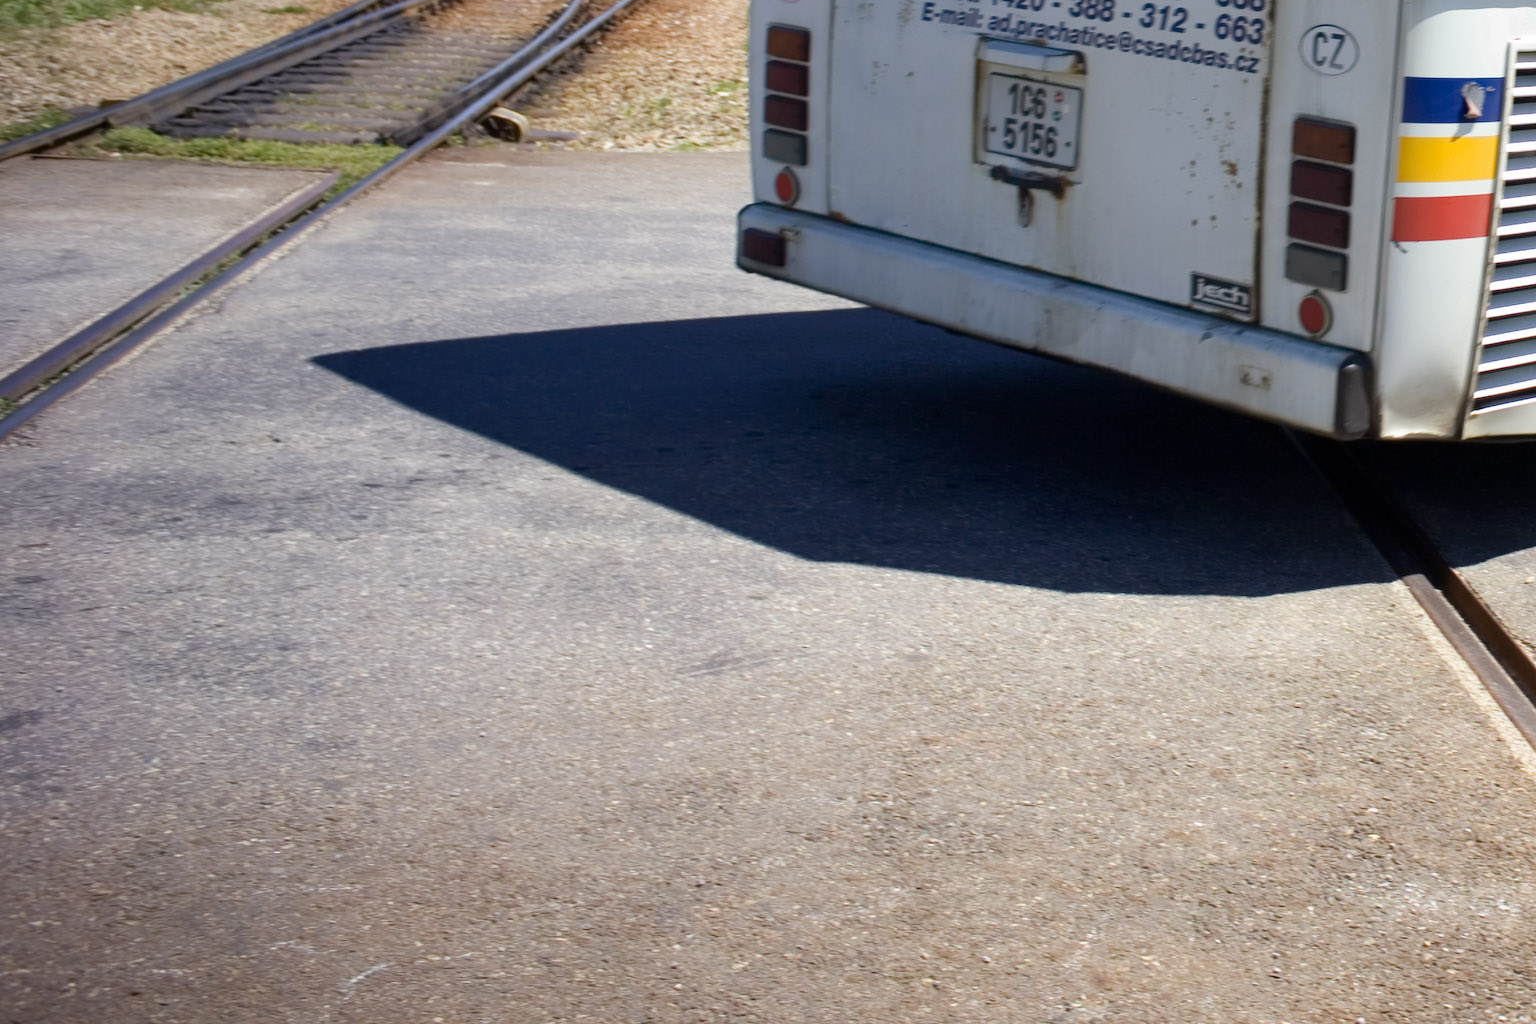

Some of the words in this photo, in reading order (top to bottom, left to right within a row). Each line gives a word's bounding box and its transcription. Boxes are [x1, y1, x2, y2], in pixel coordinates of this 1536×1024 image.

[921, 2, 984, 28] E-mail:
[987, 13, 1260, 74] ad.prachatice@csadcbas.cz
[1139, 3, 1188, 33] 312
[1215, 13, 1265, 45] 663
[1312, 31, 1346, 70] CZ
[1008, 83, 1047, 120] 1C6
[1003, 117, 1058, 158] 5156
